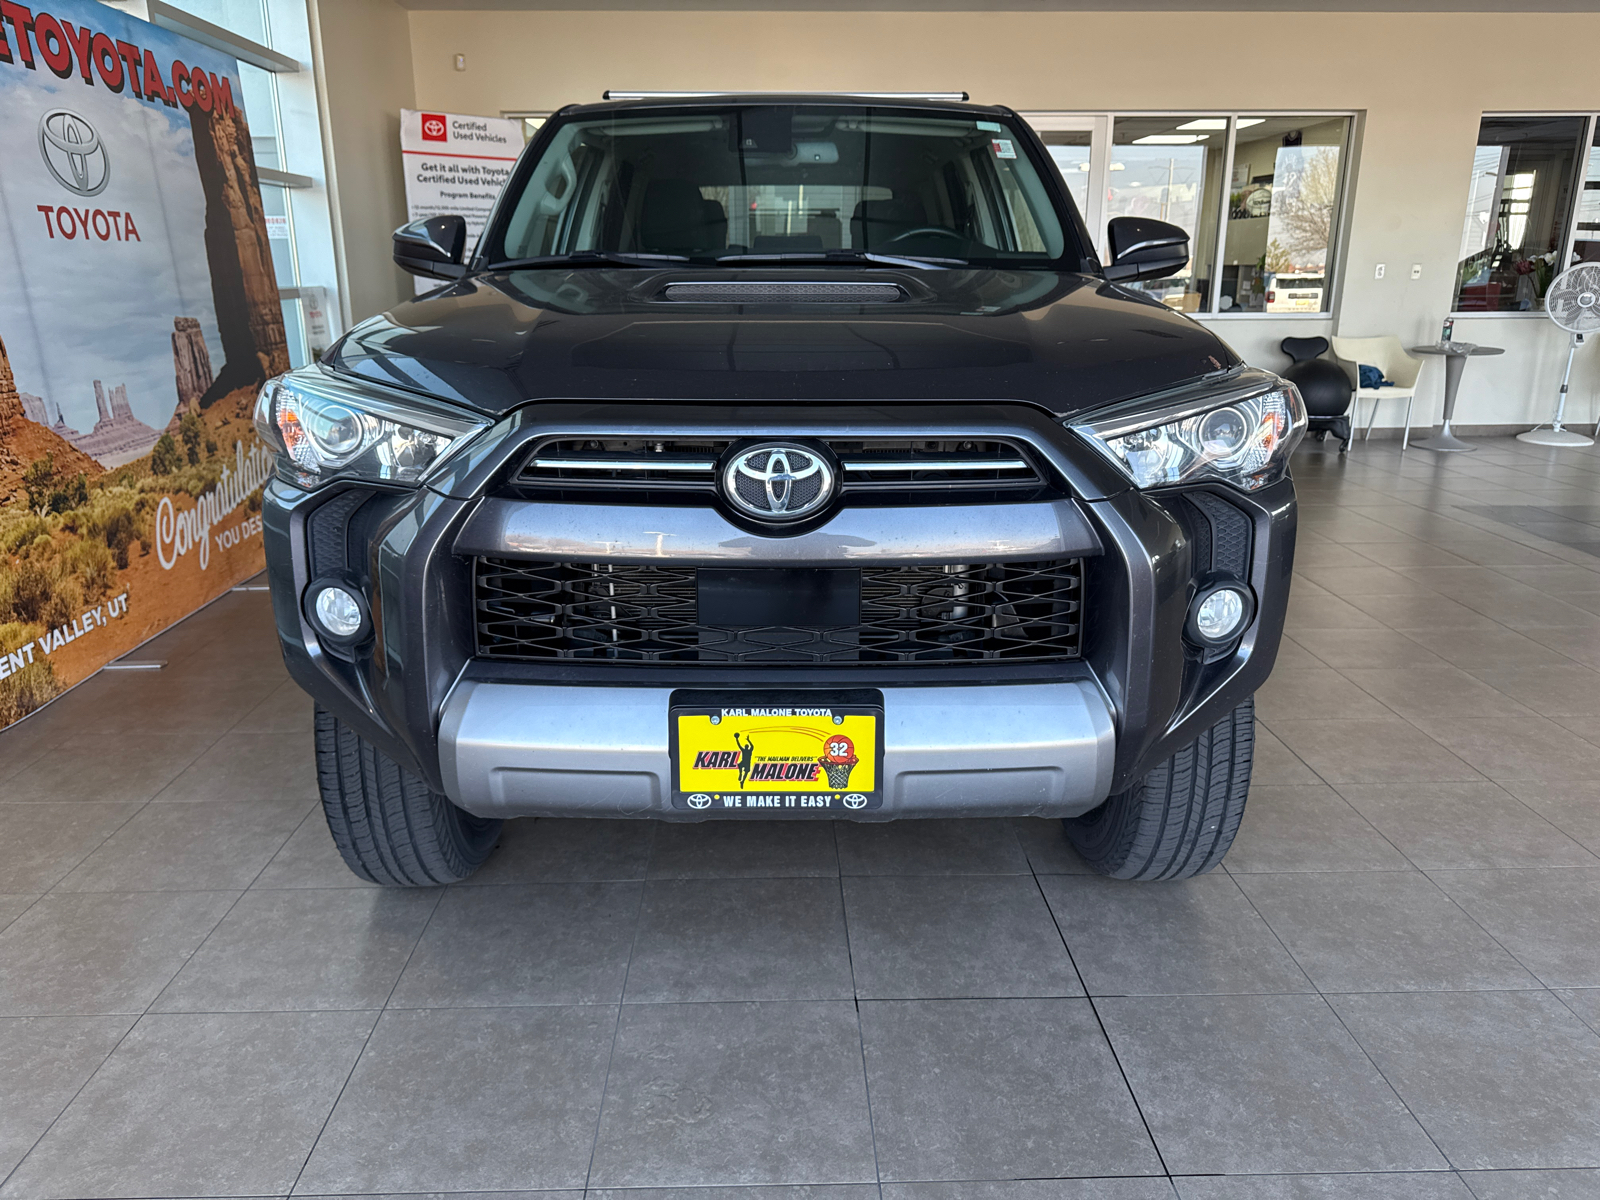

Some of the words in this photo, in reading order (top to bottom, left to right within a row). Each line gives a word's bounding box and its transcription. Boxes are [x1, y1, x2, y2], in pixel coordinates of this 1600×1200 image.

[452, 120, 487, 131] Certified
[453, 131, 474, 140] Used
[475, 133, 507, 143] Vehicles
[421, 162, 438, 172] Get
[439, 163, 446, 172] it
[448, 164, 460, 173] all
[461, 165, 480, 174] with
[481, 166, 510, 176] Toyota
[416, 174, 455, 184] Certified
[457, 176, 479, 185] Used
[440, 190, 468, 200] Program
[37, 204, 141, 242] TOYOTA
[215, 525, 240, 552] YOU
[241, 515, 262, 539] DES
[38, 605, 107, 655] VALLEY,
[107, 593, 127, 618] UT
[721, 708, 749, 717] KARL
[751, 708, 792, 717] MALONE
[794, 708, 833, 717] TOYOTA
[829, 742, 848, 757] 32
[693, 751, 741, 769] KARL
[749, 762, 820, 781] MALONE
[723, 795, 742, 807] WE
[746, 795, 781, 807] MAKE
[785, 795, 797, 807] IT
[800, 795, 832, 807] EASY
